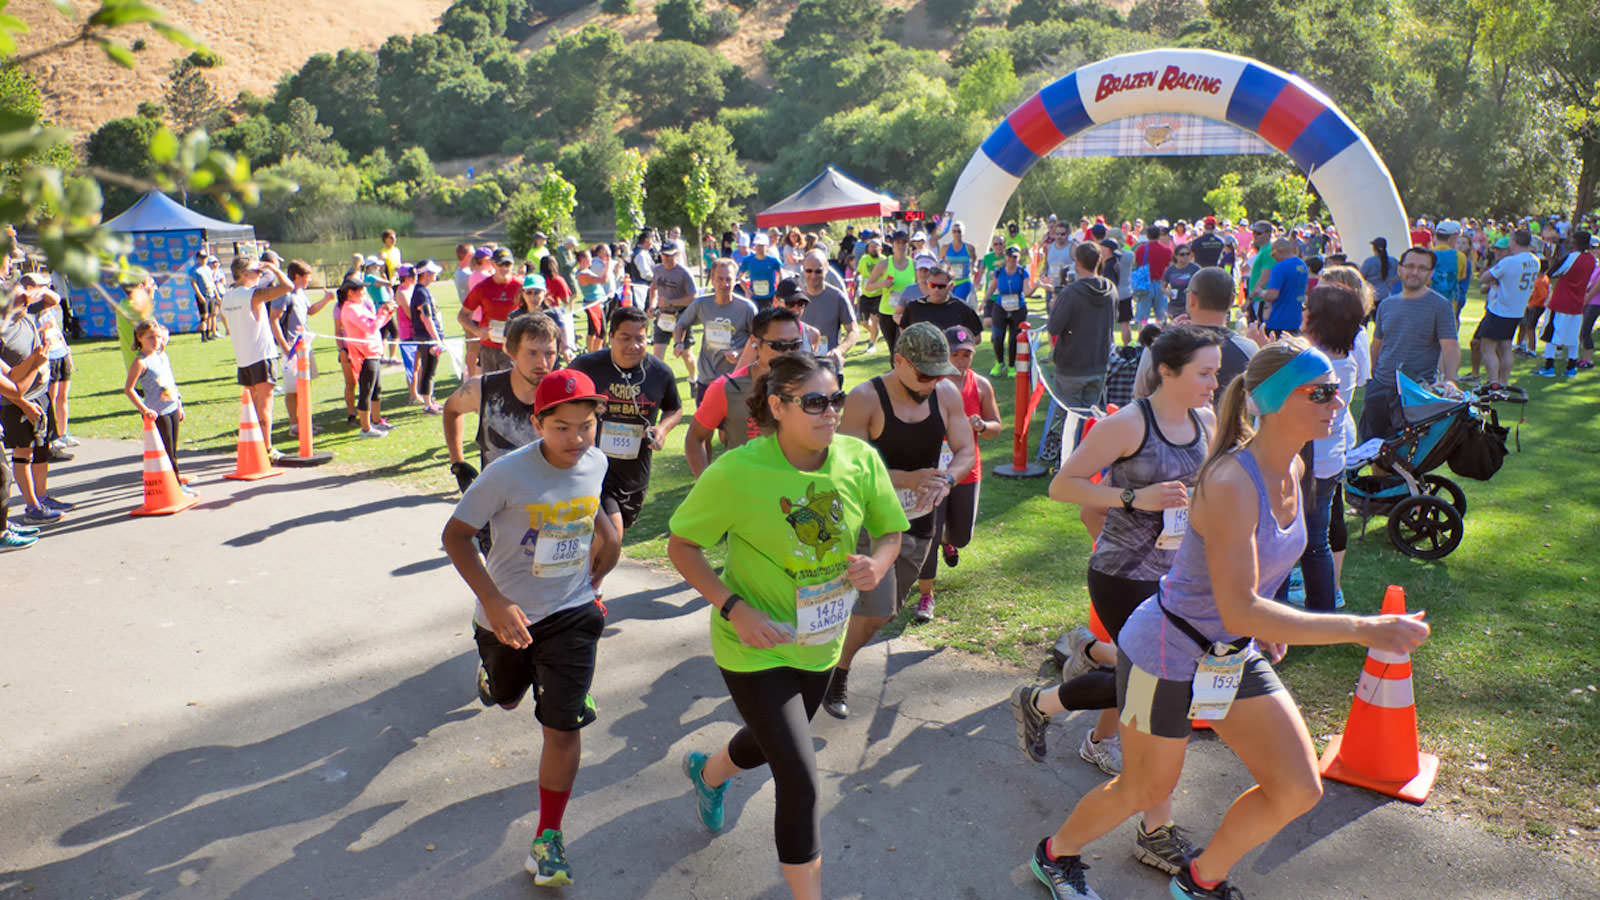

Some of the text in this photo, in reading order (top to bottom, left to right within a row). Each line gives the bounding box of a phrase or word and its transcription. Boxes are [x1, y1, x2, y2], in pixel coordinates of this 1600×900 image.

[1095, 70, 1159, 102] BRAZEN
[613, 437, 630, 447] 1555
[555, 539, 579, 552] 1518
[816, 598, 845, 619] 1479
[809, 609, 849, 632] SANDRA
